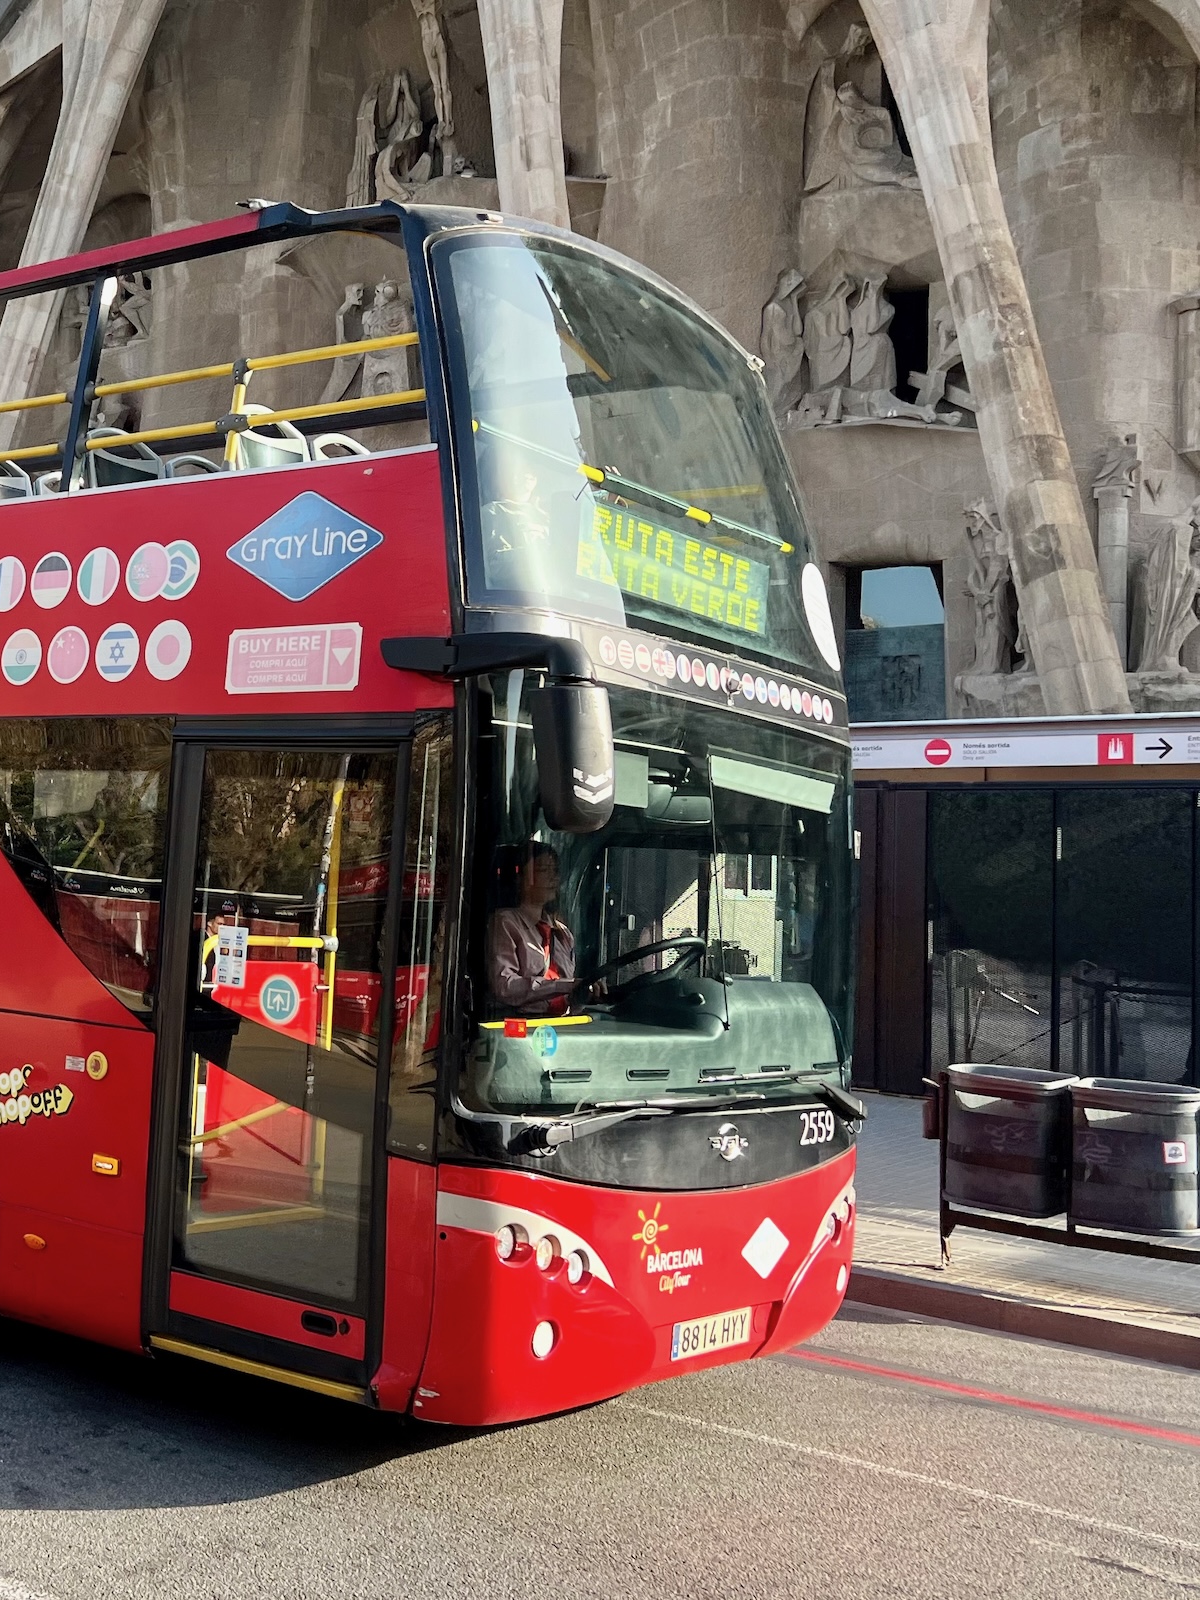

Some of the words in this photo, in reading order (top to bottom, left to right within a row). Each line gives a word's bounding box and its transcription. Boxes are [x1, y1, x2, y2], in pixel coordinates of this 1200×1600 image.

[591, 506, 674, 567] RUTA
[684, 539, 750, 593] ESTE
[576, 541, 659, 600] RUTA
[238, 638, 272, 654] BUY
[276, 635, 321, 652] HERE
[247, 673, 283, 684] COMPRE
[249, 658, 284, 669] COMPRI
[800, 1109, 835, 1146] 2559
[647, 1247, 703, 1273] BARCELONA
[682, 1320, 717, 1352] 8814
[721, 1313, 747, 1344] HYY
